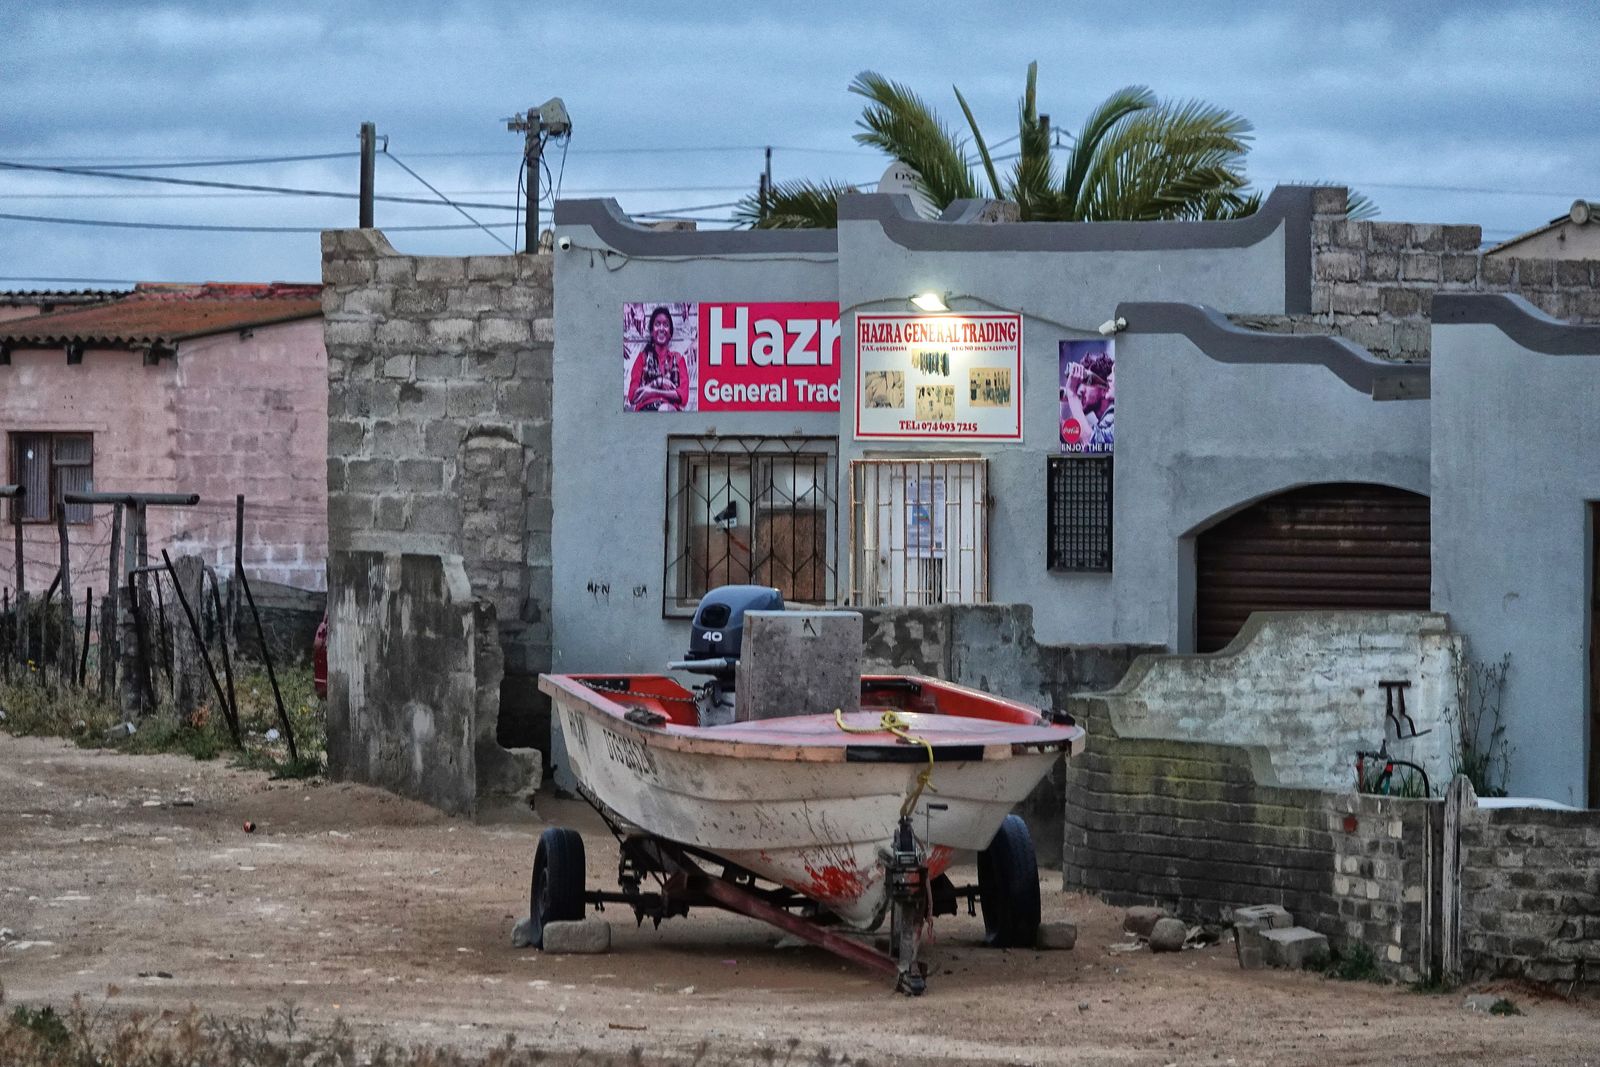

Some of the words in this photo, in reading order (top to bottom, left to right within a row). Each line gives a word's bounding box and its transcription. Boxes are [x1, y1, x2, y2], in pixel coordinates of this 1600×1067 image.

[709, 307, 841, 366] Hazr
[861, 322, 902, 343] HAZRA
[904, 321, 961, 343] GENERAL
[961, 321, 1017, 343] TRADING
[704, 378, 787, 403] General
[794, 378, 841, 403] Trad
[898, 420, 920, 431] TEL:
[1061, 443, 1086, 452] ENJOY
[1088, 443, 1103, 452] THE
[702, 631, 723, 642] 40
